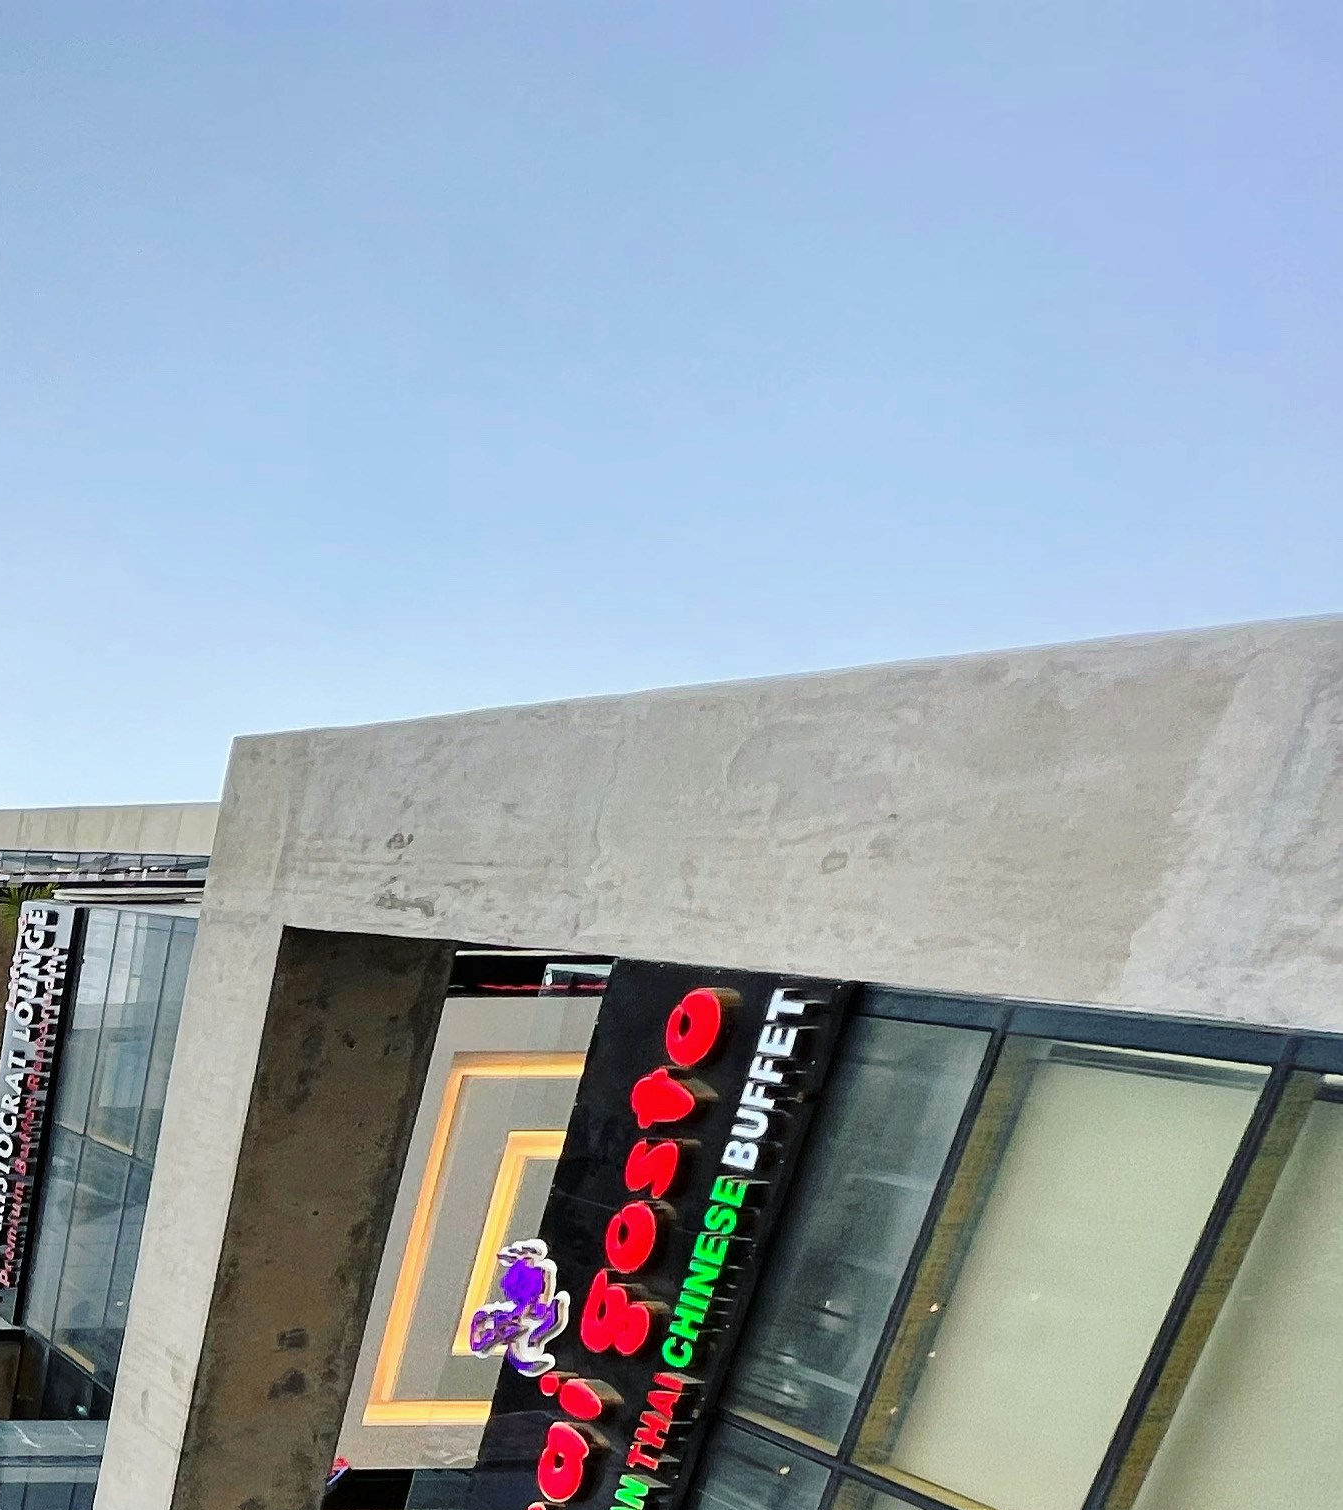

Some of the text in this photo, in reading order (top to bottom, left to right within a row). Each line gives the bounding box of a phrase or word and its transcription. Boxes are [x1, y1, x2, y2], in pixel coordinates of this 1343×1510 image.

[11, 907, 49, 1042] LOUNGE
[627, 1373, 687, 1471] THAI
[662, 1176, 749, 1368] CHINESE
[721, 986, 811, 1171] BUFFET
